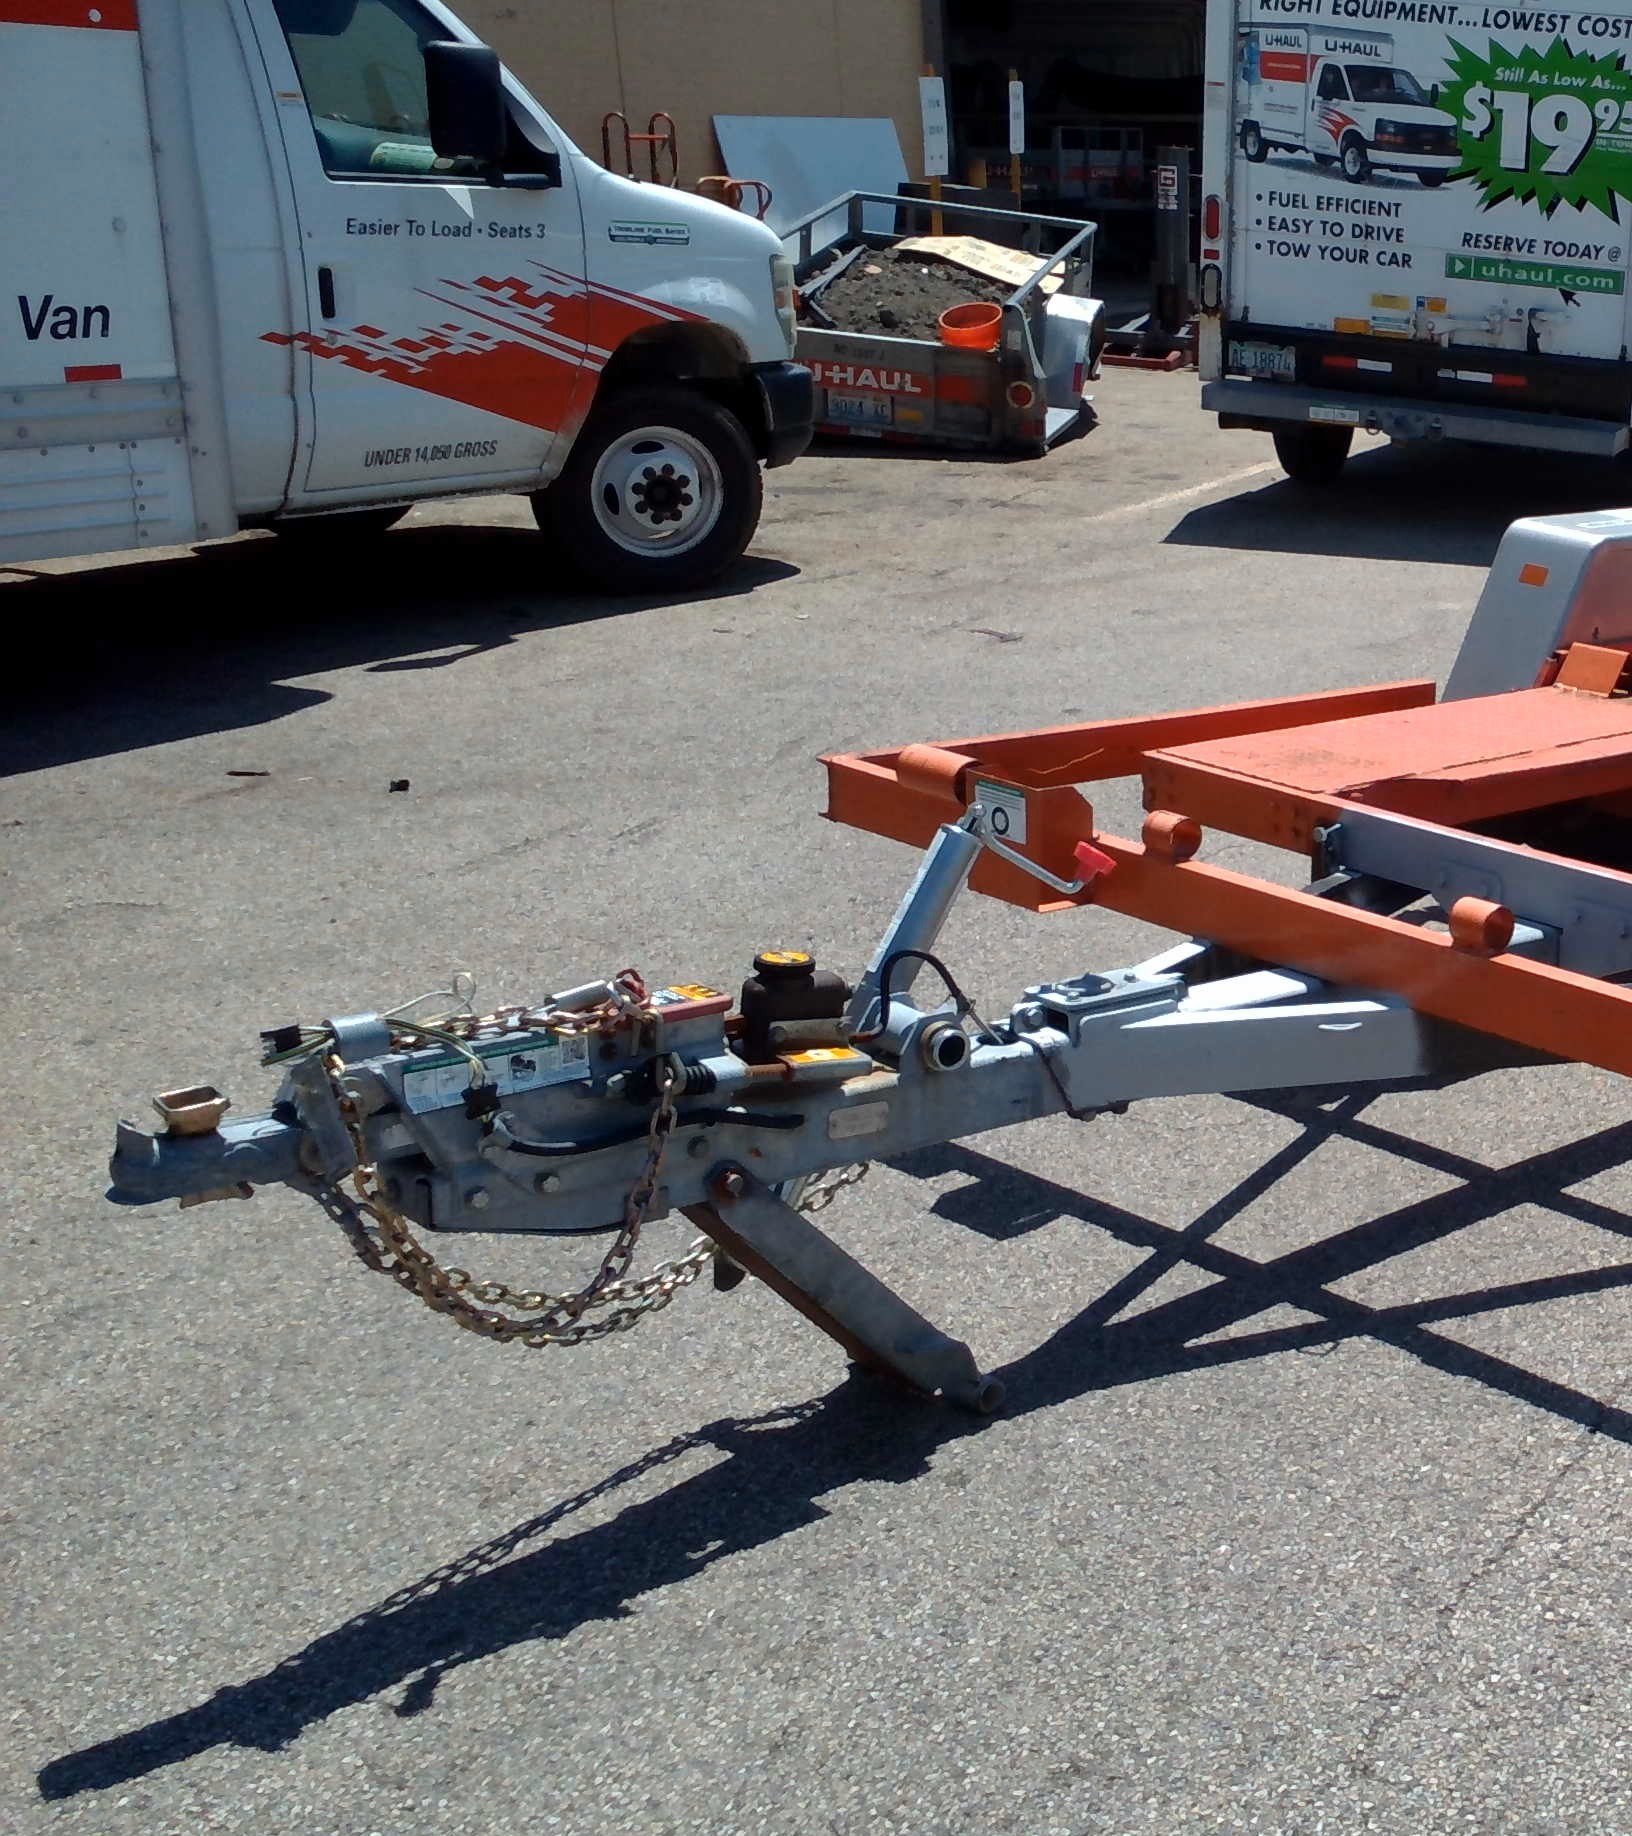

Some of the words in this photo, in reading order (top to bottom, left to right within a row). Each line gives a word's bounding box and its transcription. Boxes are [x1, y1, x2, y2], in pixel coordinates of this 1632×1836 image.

[1260, 0, 1323, 14] RIGHT
[1265, 33, 1302, 48] U-HAUL
[1325, 39, 1381, 57] U-HAUL
[1495, 66, 1524, 81] Still
[1528, 70, 1548, 84] As
[1553, 71, 1585, 86] Low
[1592, 75, 1627, 91] As...
[1268, 191, 1309, 209] FUEL
[1316, 195, 1403, 218] EFFICIENT
[345, 218, 400, 236] Easier
[405, 219, 426, 237] To
[432, 221, 472, 238] Load
[488, 222, 532, 239] Seats
[536, 223, 546, 239] 3
[1267, 216, 1314, 234] EASY
[1320, 220, 1344, 237] TO
[1351, 223, 1404, 243] DRIVE
[1267, 240, 1311, 258] TOW
[1318, 245, 1369, 264] YOUR
[1376, 250, 1412, 269] CAR
[1461, 232, 1537, 254] RESERVE
[1543, 240, 1605, 260] TODAY
[1481, 259, 1614, 289] uhaul.com
[17, 294, 110, 340] Van
[364, 448, 411, 468] UNDER
[454, 440, 498, 458] GROSS
